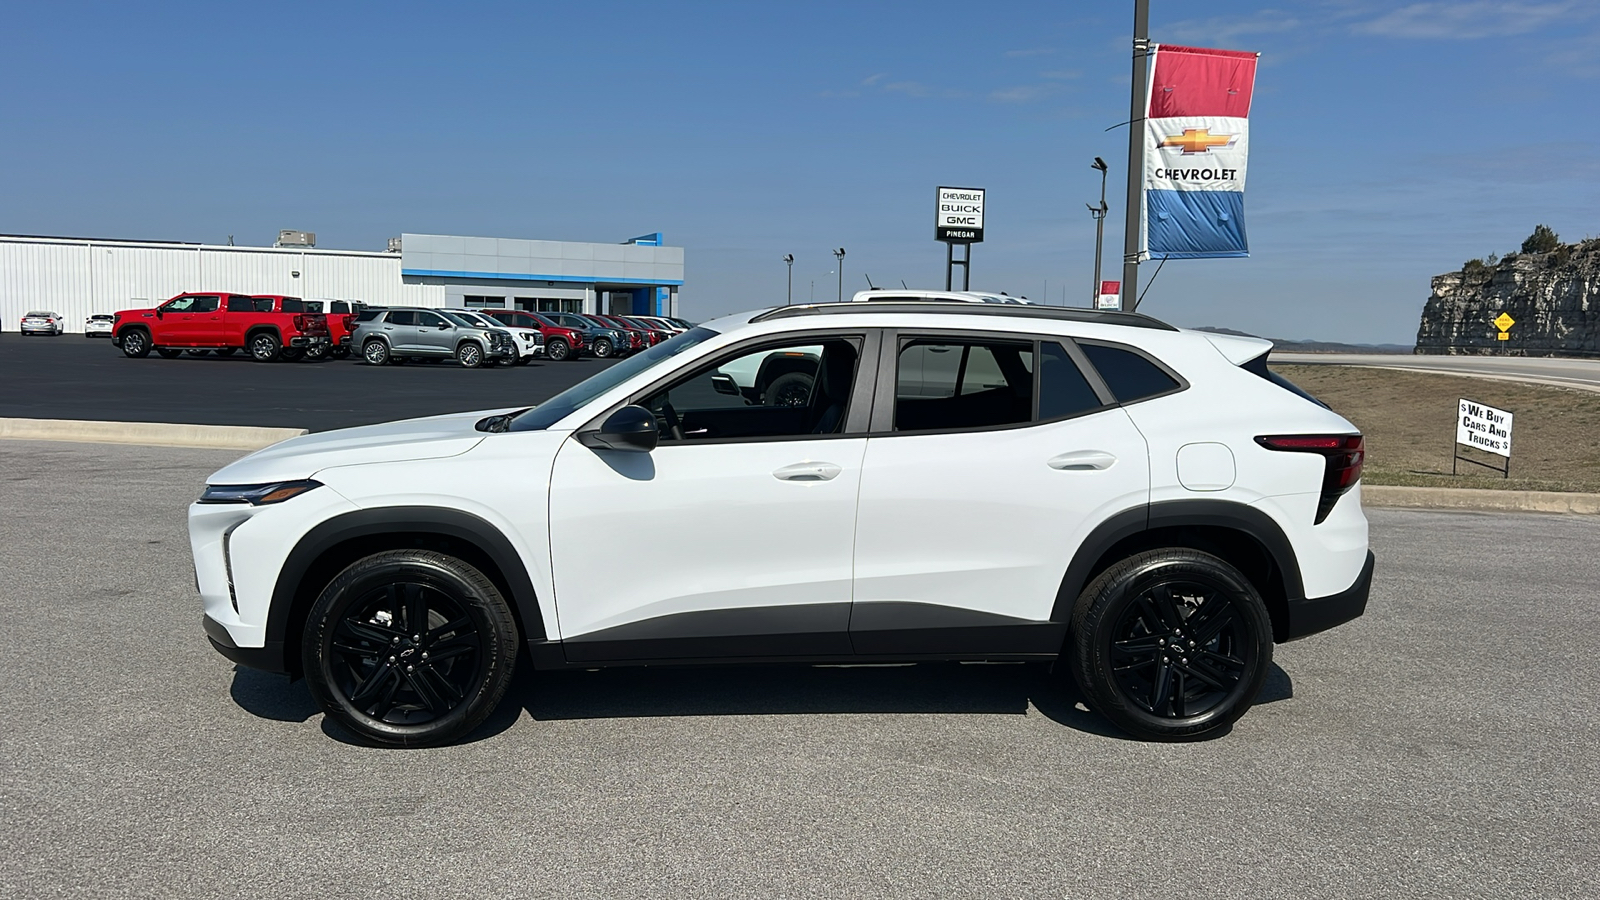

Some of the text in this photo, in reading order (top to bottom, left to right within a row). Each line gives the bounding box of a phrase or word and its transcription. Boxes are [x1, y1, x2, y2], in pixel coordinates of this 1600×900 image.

[1155, 168, 1237, 180] CHEVROLET
[943, 193, 981, 201] CHEVROLET
[942, 205, 981, 213] BUICK
